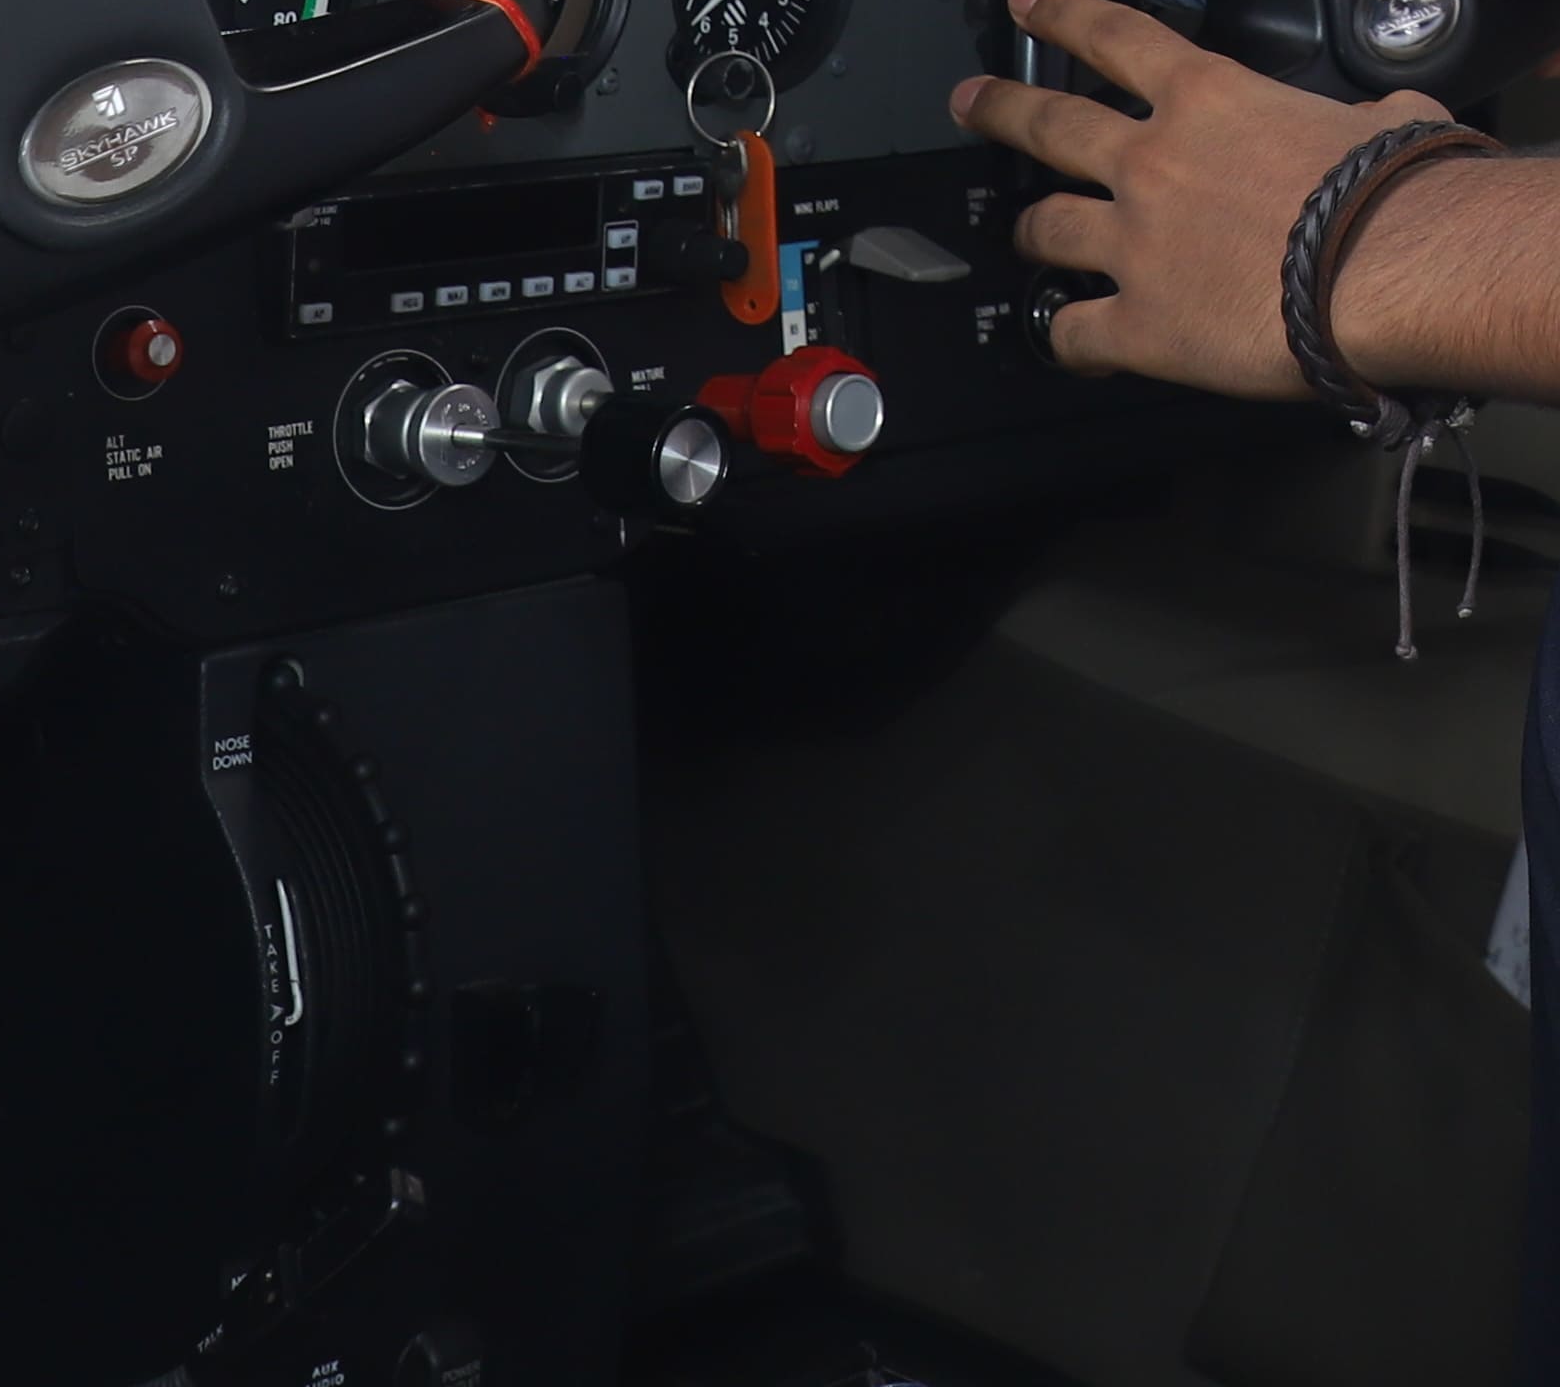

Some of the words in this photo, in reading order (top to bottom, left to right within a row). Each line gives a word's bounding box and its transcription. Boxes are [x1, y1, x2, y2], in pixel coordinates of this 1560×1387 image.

[699, 14, 712, 34] 6
[757, 10, 770, 27] 4
[727, 27, 740, 46] 5
[60, 107, 178, 169] SKYHAWK
[109, 145, 140, 169] SP
[815, 196, 841, 215] FLAPS
[267, 419, 315, 440] THROTTLE
[105, 433, 126, 450] ALT
[267, 438, 294, 457] PUSH
[106, 447, 143, 466] STATIC
[145, 443, 164, 460] AIR
[267, 454, 295, 472] OPEN
[106, 464, 133, 482] PULL
[137, 461, 153, 478] ON
[214, 734, 252, 754] NOSE
[211, 751, 254, 772] DOWN
[263, 923, 281, 996] TAKE
[195, 1322, 224, 1355] TALK
[312, 1358, 340, 1381] AUX
